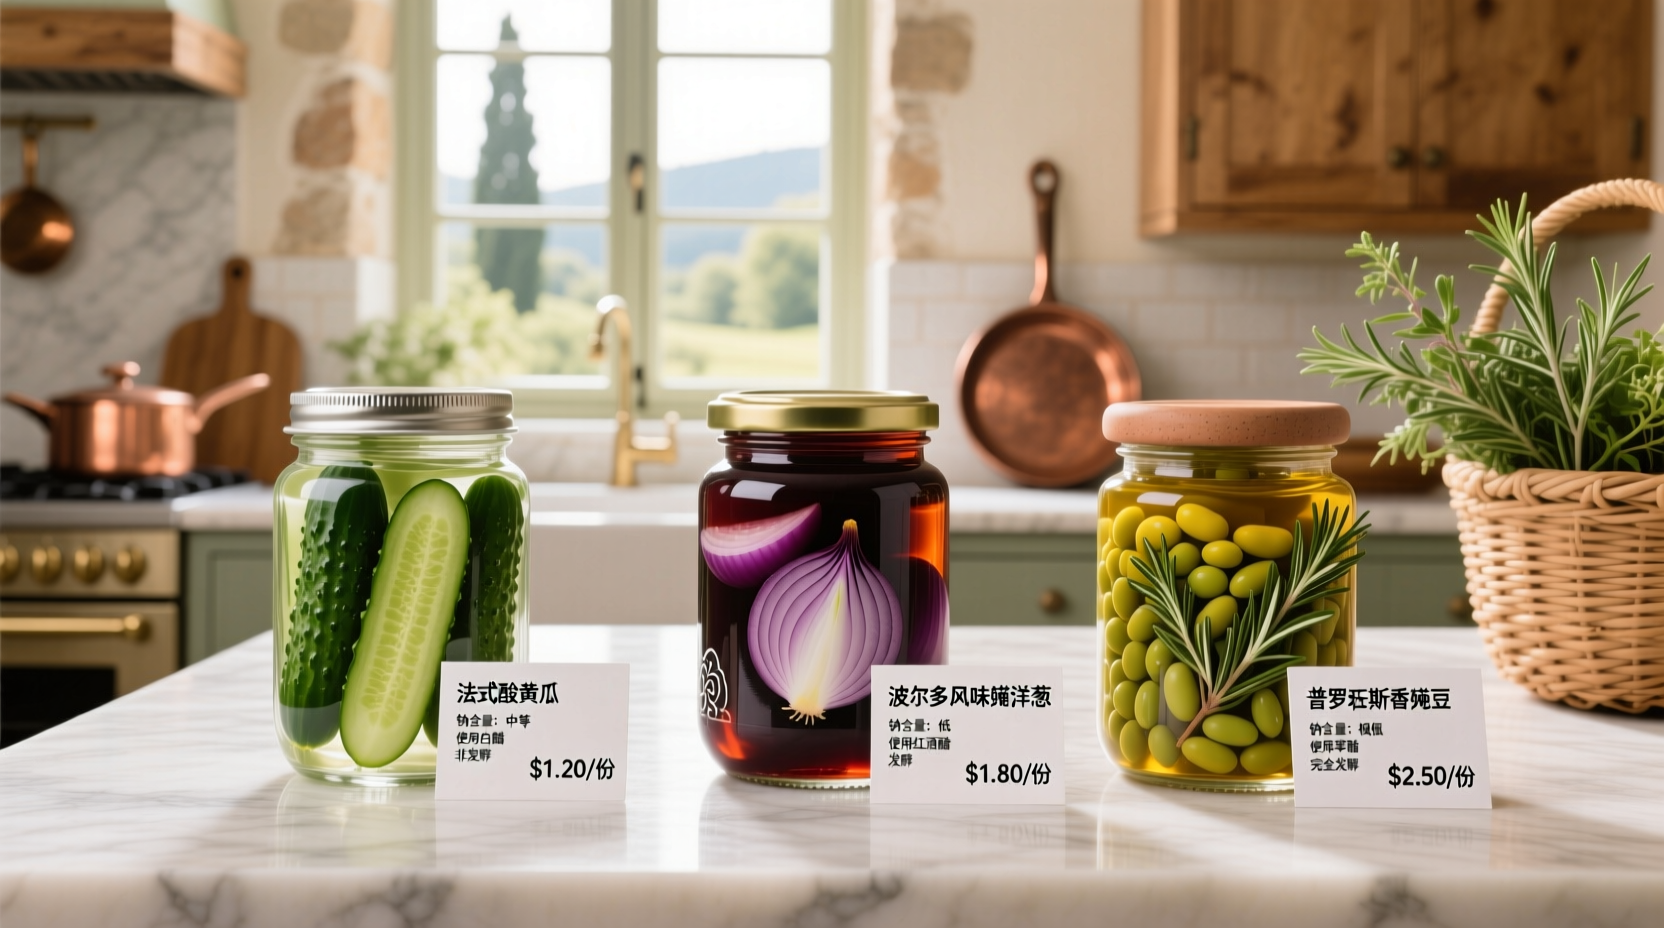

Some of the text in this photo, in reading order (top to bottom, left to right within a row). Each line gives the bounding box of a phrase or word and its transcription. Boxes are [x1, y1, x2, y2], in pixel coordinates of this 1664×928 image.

[457, 681, 559, 704] 法式酸黄瓜
[530, 756, 615, 781] $1.20/份
[966, 761, 1051, 786] $1.80/份
[1387, 763, 1475, 789] $2.50/份
